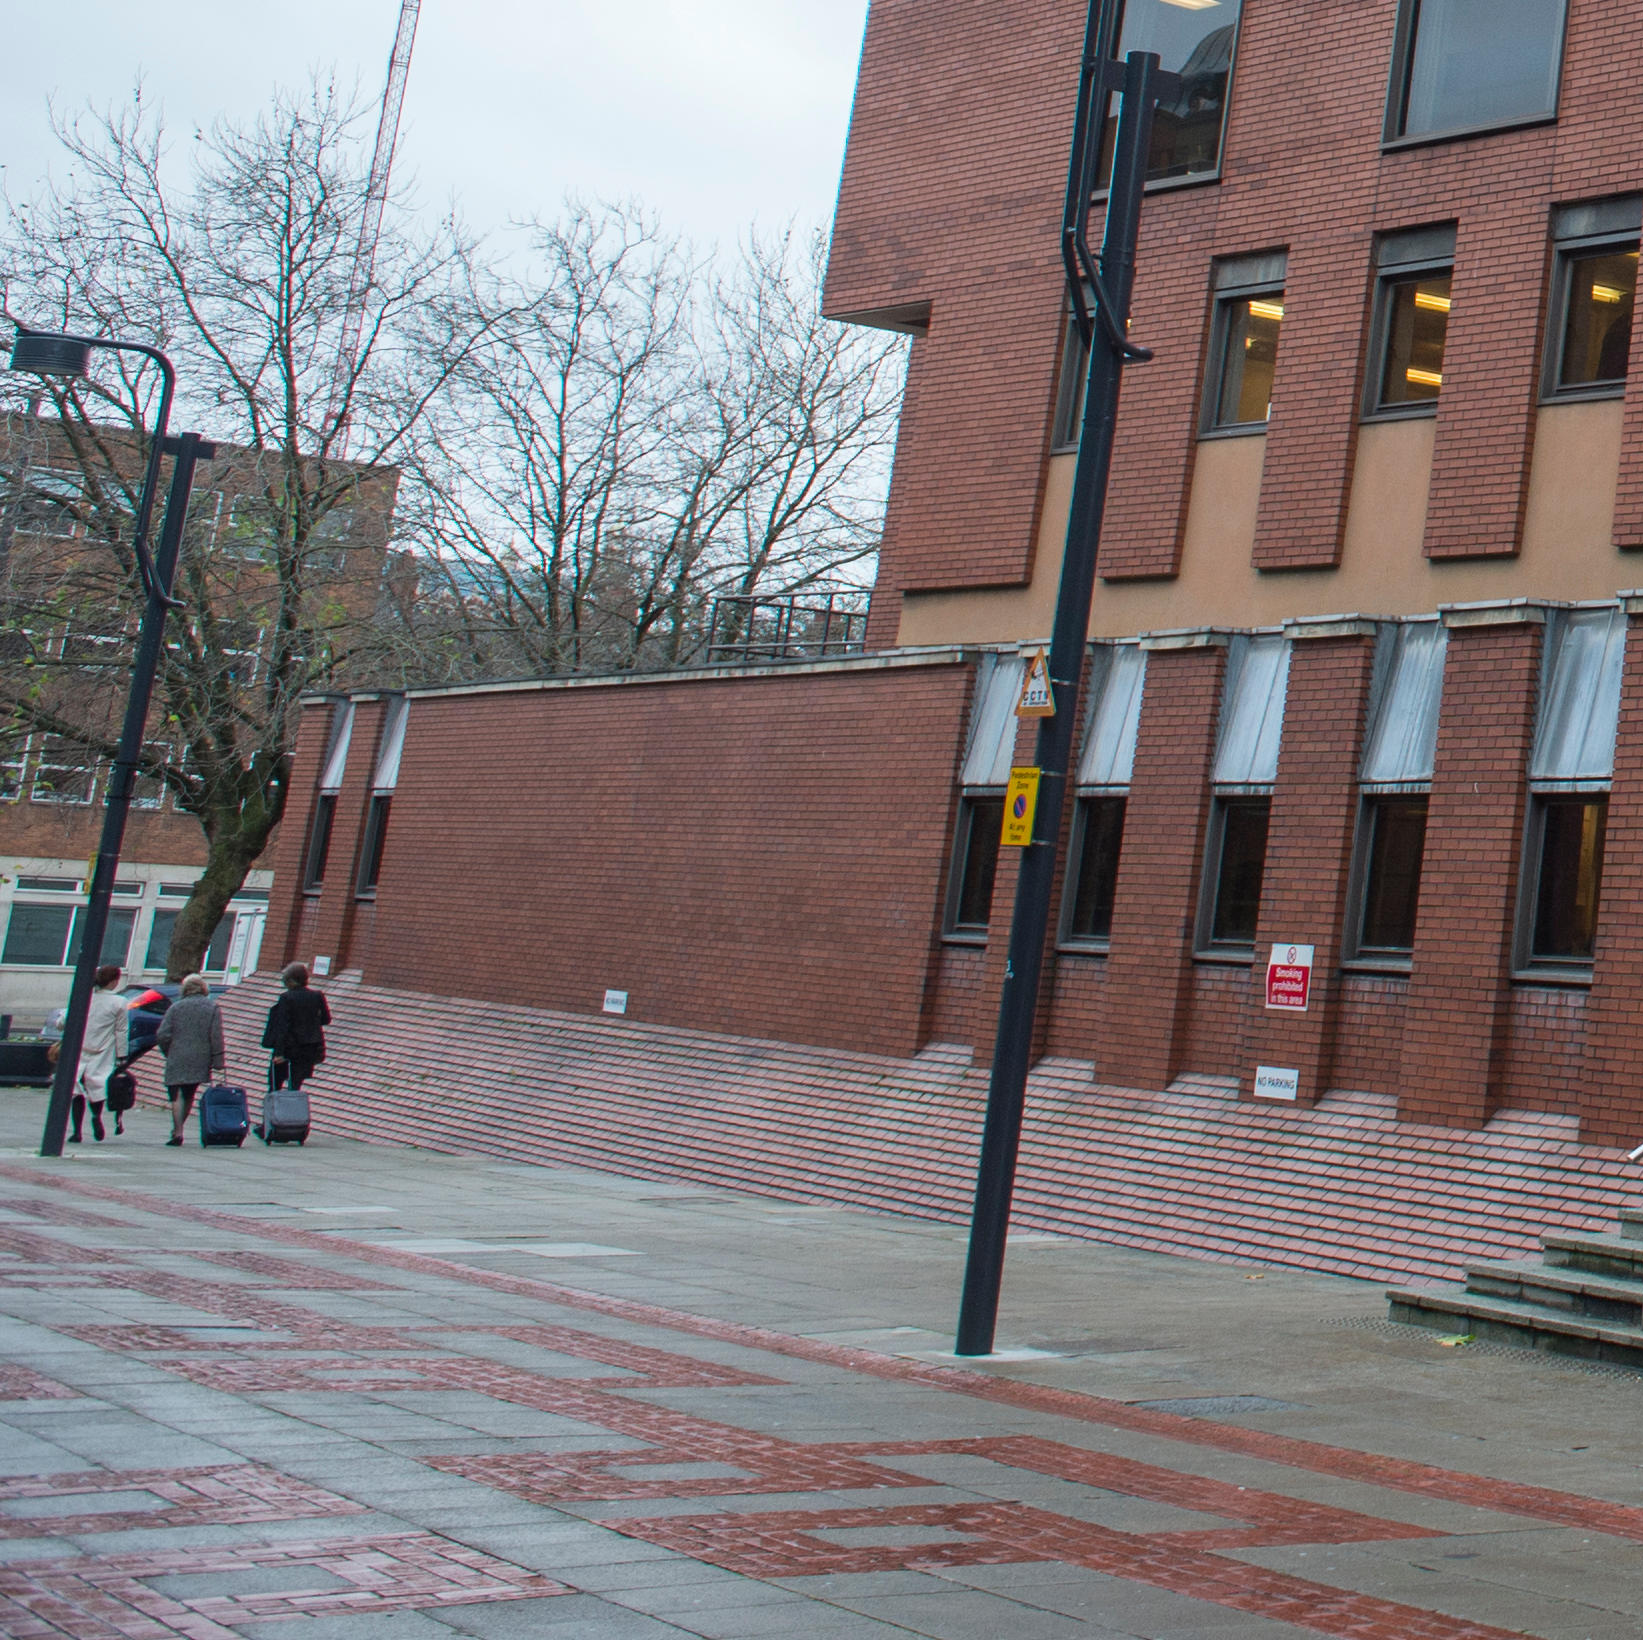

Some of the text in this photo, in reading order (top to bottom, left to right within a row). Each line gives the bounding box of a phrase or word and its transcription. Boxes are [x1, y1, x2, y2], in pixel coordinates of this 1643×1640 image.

[1023, 690, 1049, 701] CCTV
[1275, 967, 1303, 981] Smoking
[1271, 980, 1304, 992] prohibited
[1257, 1076, 1295, 1090] NO PARKING
